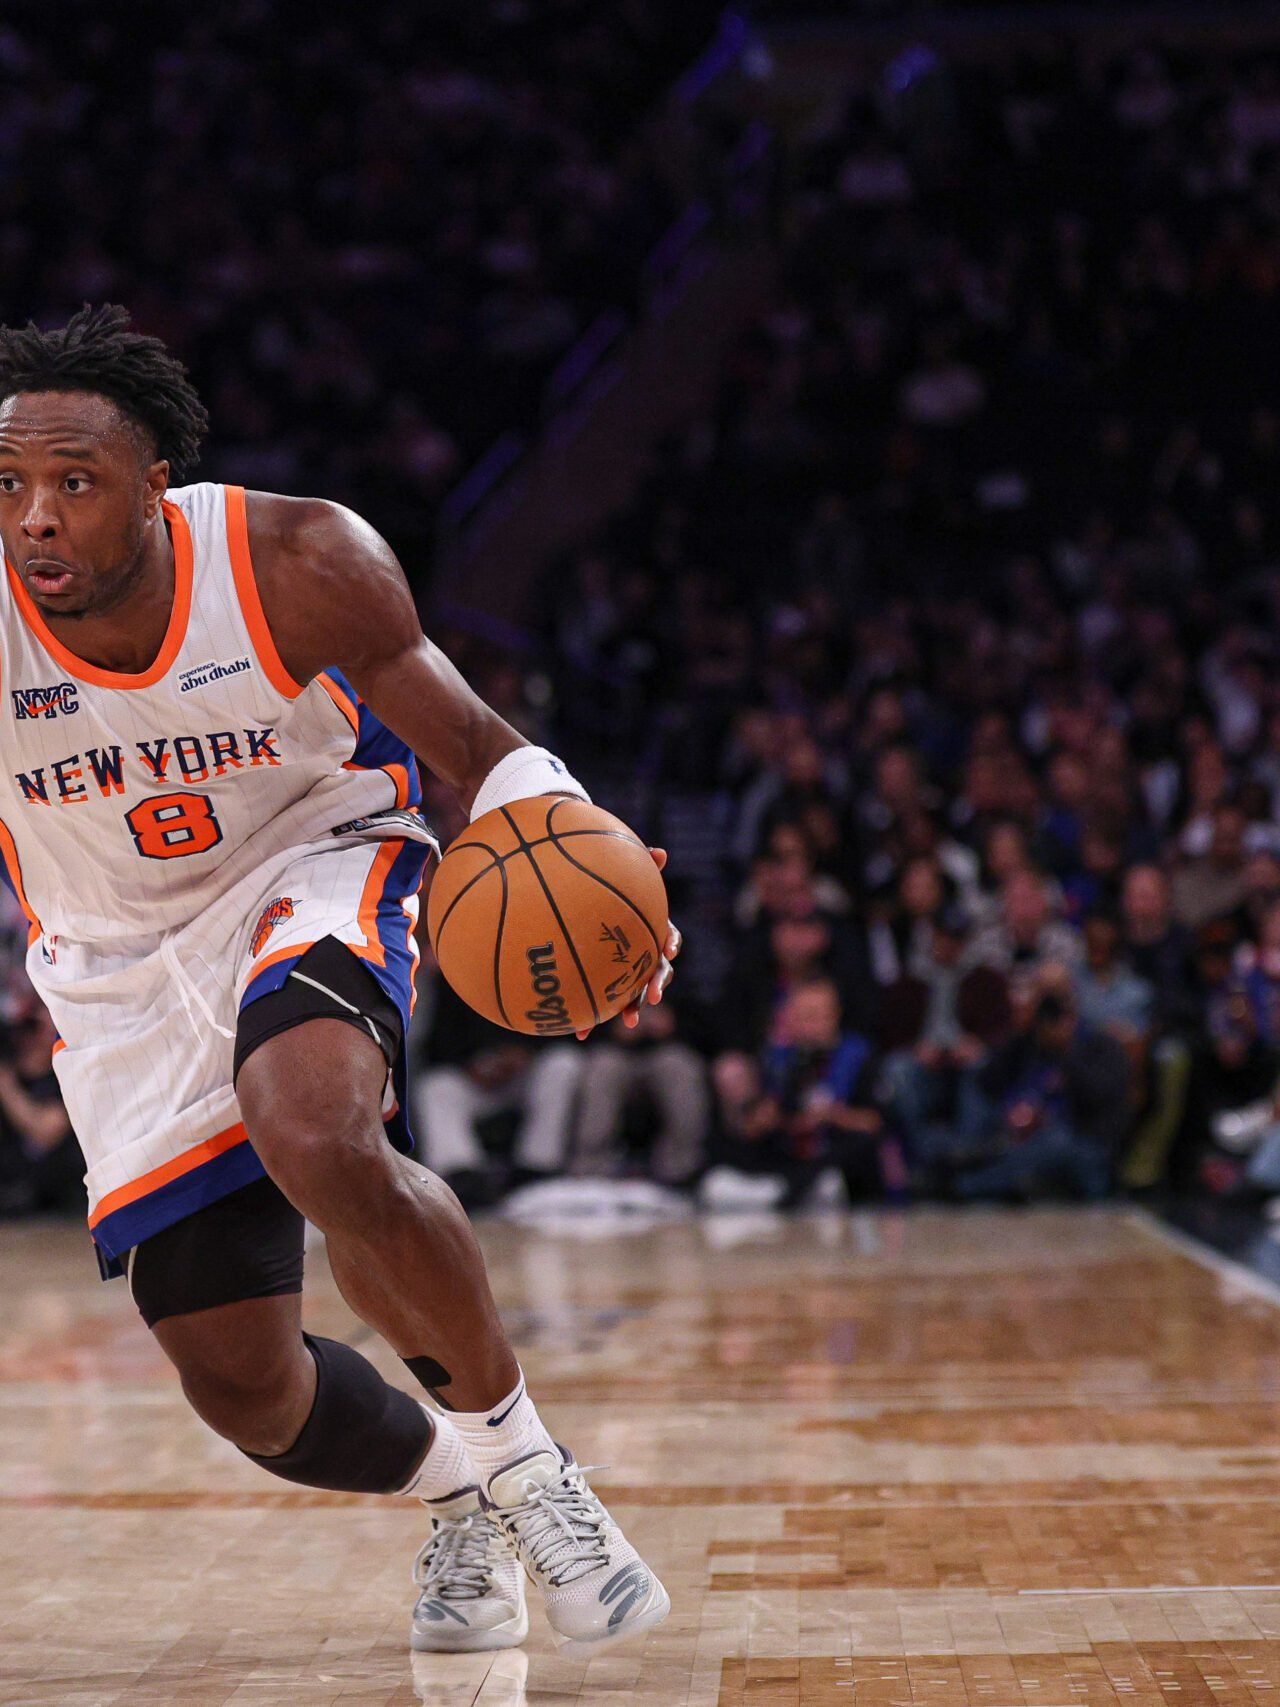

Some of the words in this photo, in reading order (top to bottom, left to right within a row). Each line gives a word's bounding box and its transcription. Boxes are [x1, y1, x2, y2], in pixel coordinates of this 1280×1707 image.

[178, 662, 216, 680] experience
[180, 674, 209, 692] abu
[209, 657, 251, 681] dhabi
[12, 682, 80, 720] NYC
[15, 745, 126, 807] NEW
[136, 728, 282, 784] YORK
[123, 791, 224, 861] 8
